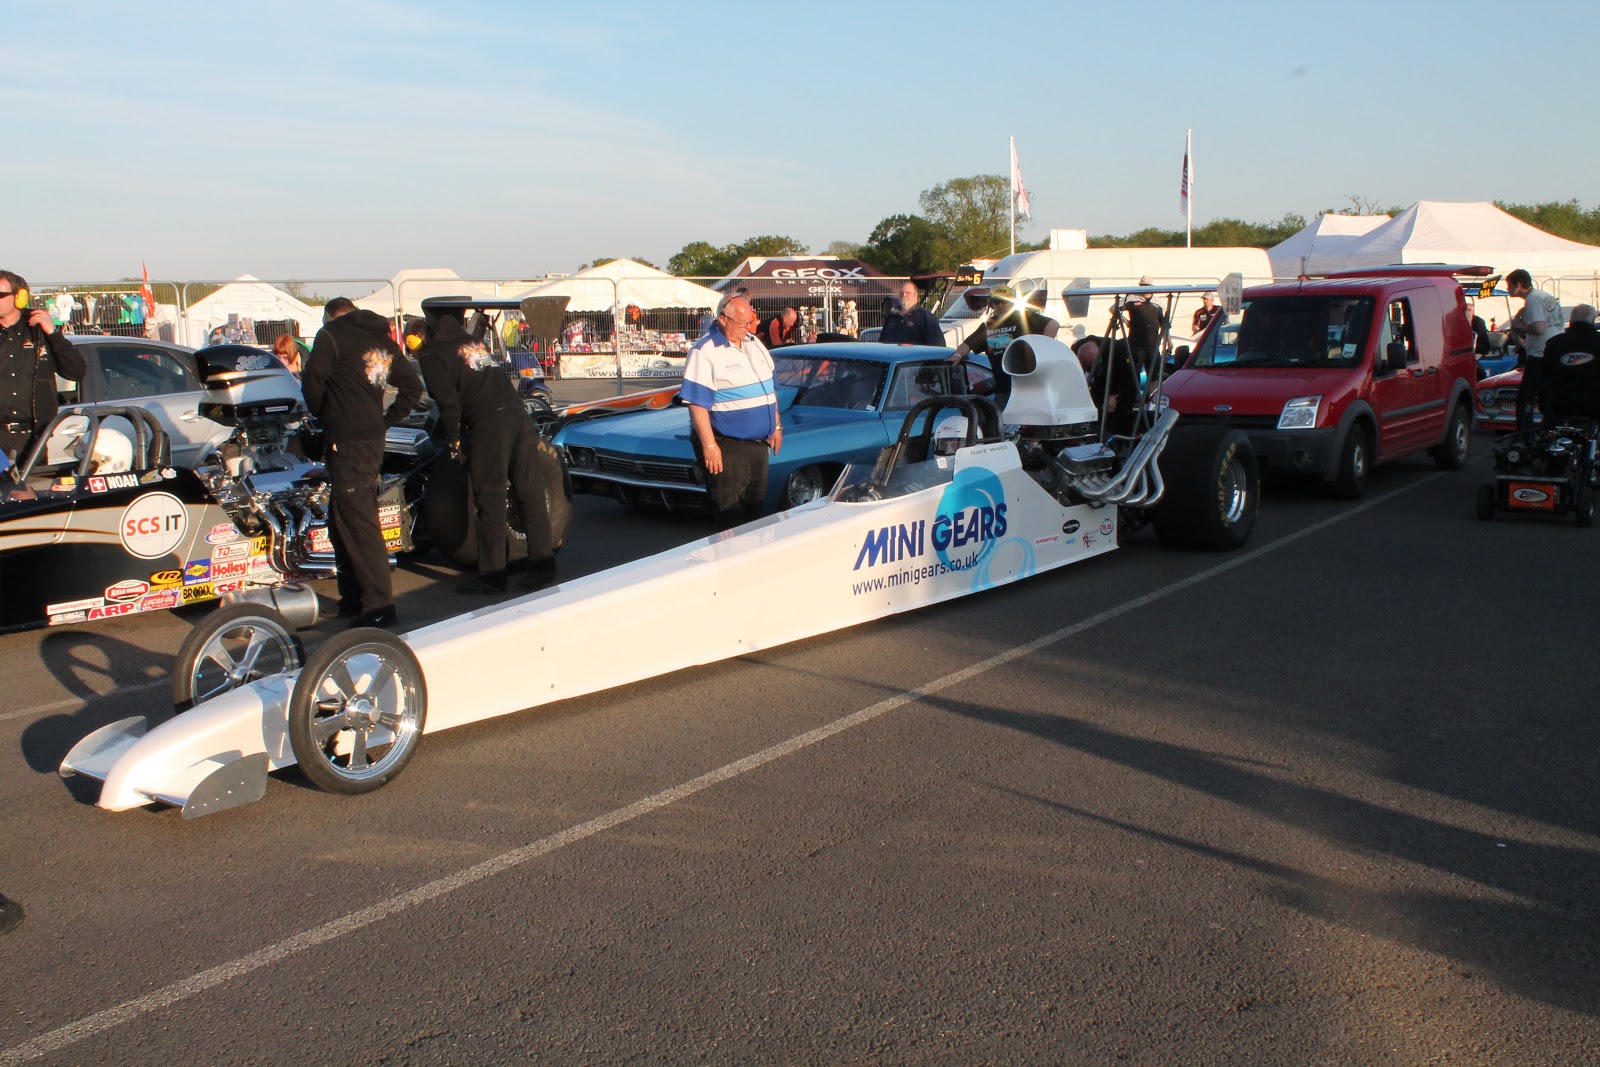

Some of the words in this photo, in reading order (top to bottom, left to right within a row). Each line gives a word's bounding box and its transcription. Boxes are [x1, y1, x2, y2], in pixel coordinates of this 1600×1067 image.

[771, 266, 865, 279] GEOX
[973, 273, 982, 285] 6
[106, 474, 139, 489] NOAH
[126, 516, 161, 537] SCS
[165, 513, 182, 532] IT
[852, 519, 926, 572] MINI
[930, 502, 1008, 552] GEARS
[212, 562, 247, 577] Holley
[852, 550, 979, 596] www.minigears.co.uk
[143, 598, 163, 606] LUCAS
[89, 602, 135, 619] ARP
